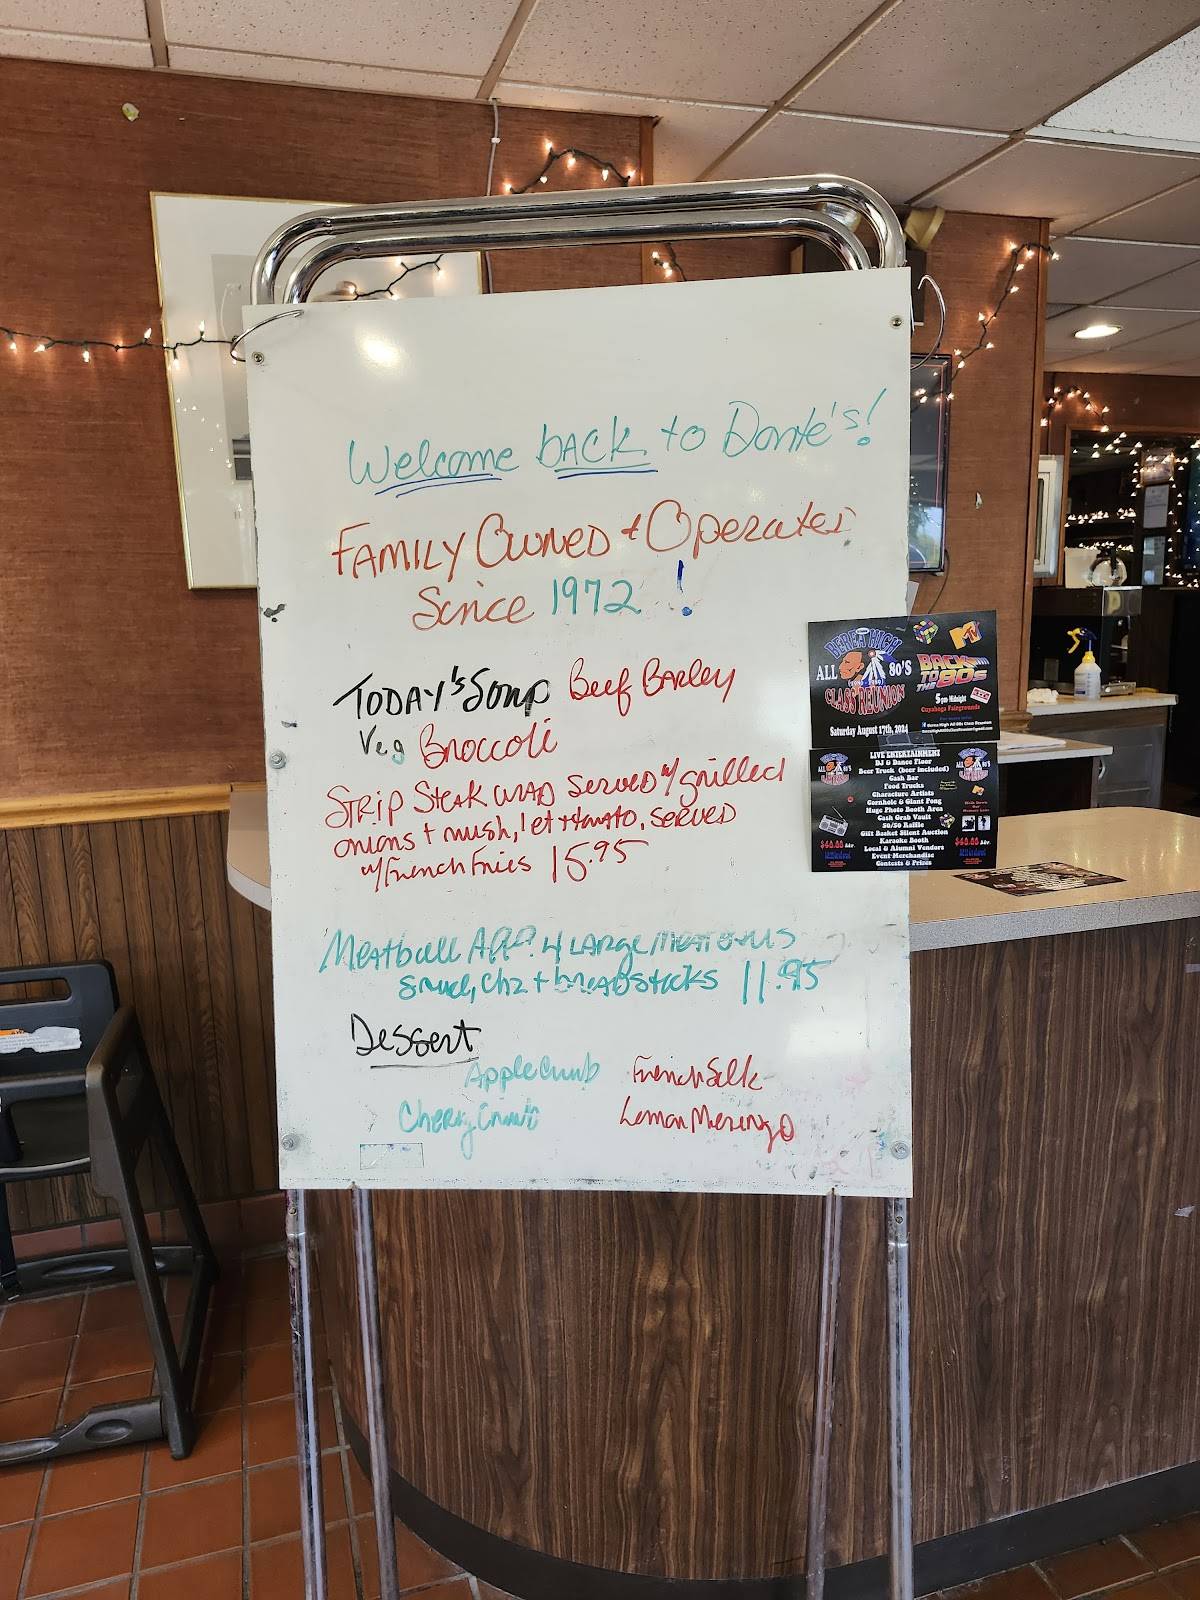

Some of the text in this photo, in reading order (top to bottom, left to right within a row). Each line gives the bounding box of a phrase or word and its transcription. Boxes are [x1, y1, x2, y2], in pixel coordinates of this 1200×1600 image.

[349, 440, 519, 484] Welcome
[661, 413, 706, 452] to
[552, 578, 641, 616] 1972
[868, 628, 903, 656] HIGH
[816, 660, 912, 681] ALL 80'S
[917, 654, 979, 671] BACK
[920, 671, 939, 683] TO
[569, 657, 631, 717] Beef
[825, 684, 905, 715] CLASS REUNION
[916, 682, 937, 693] THE
[419, 717, 558, 769] Broccoli
[830, 726, 857, 738] Saturday
[857, 725, 878, 738] August
[870, 749, 941, 759] LIVE ENTERTAINMENT
[552, 839, 650, 883] 15.95
[351, 1013, 481, 1057] Dessert
